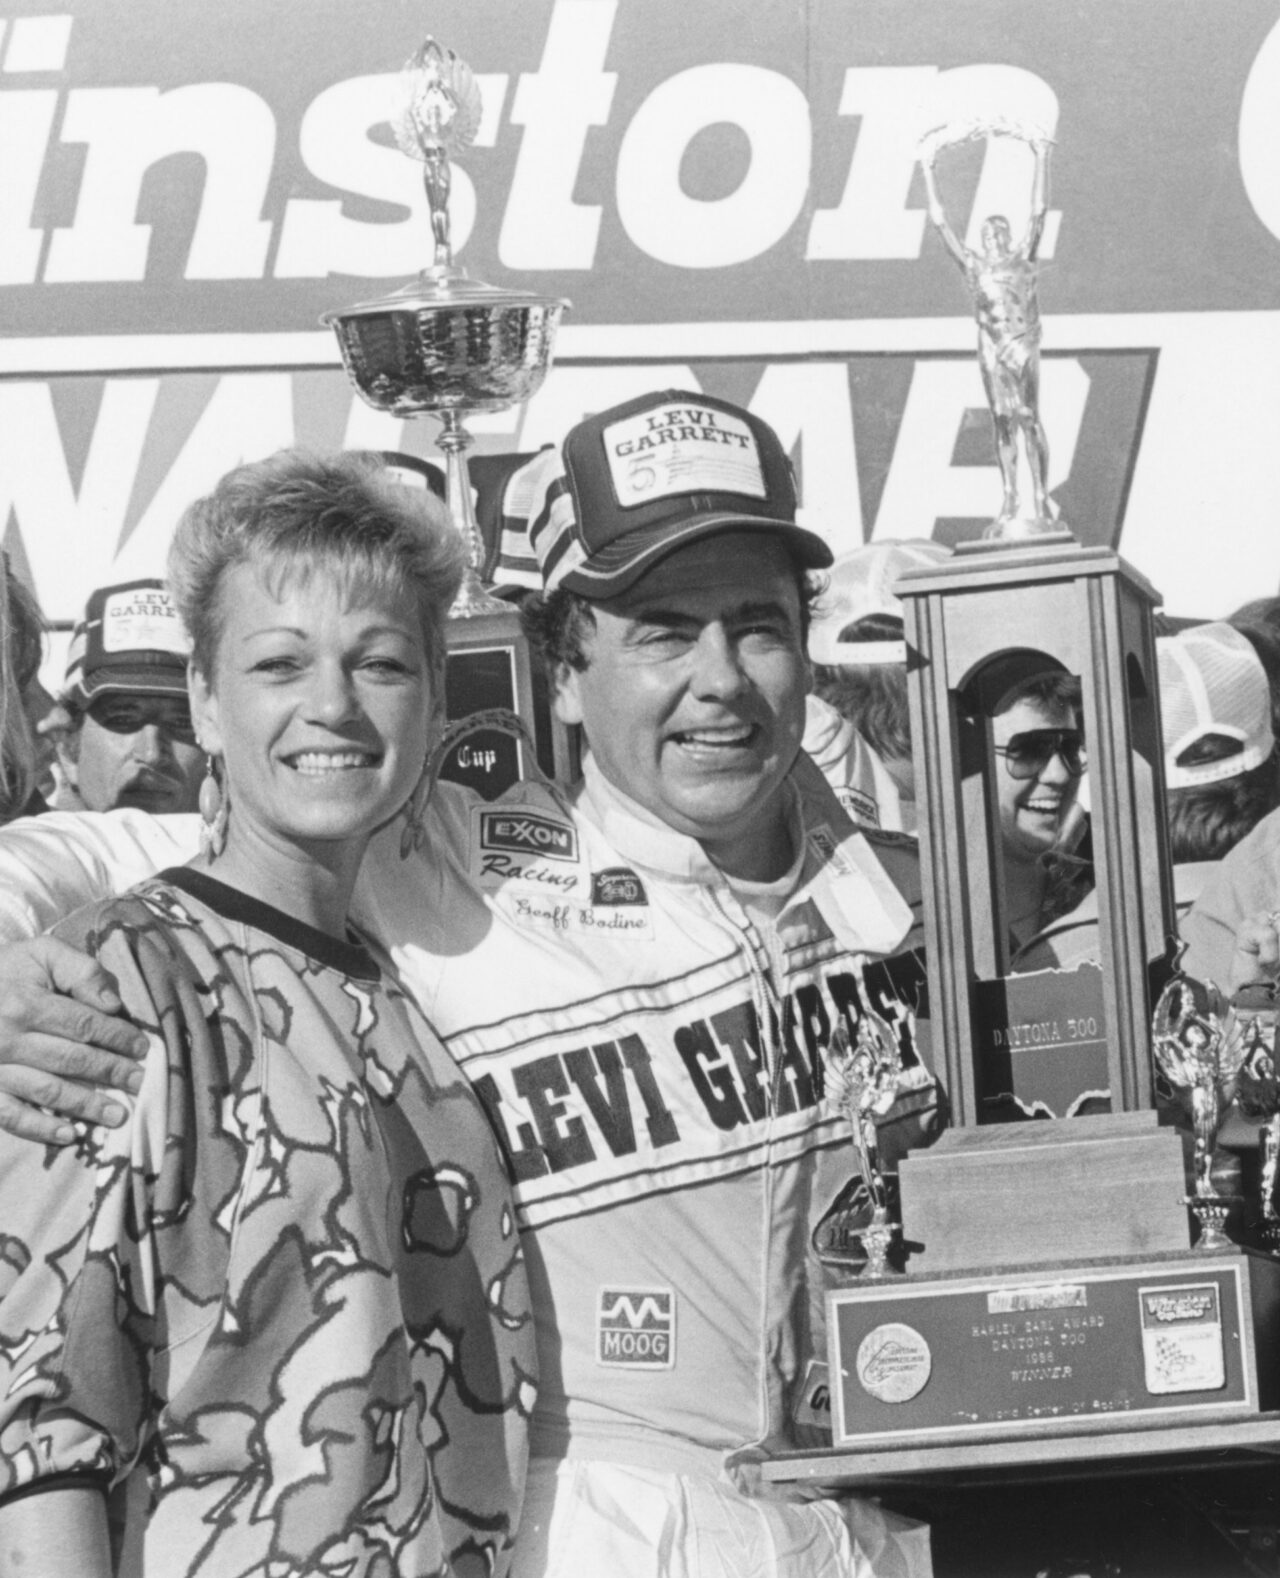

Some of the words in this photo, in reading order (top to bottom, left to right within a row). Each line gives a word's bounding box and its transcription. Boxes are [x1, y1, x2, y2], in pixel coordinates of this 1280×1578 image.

[0, 0, 1061, 285] inston
[646, 409, 718, 432] LEVI
[615, 426, 750, 458] GARRETT
[110, 605, 176, 618] GARRE
[133, 594, 170, 605] LEV
[457, 745, 497, 773] Cup
[495, 820, 569, 848] EXXON
[479, 853, 579, 893] Racing
[578, 907, 647, 930] Bodine
[993, 1023, 1061, 1047] DAYTONA
[1067, 1016, 1097, 1039] 500
[470, 1032, 681, 1186] LEVI
[603, 1332, 666, 1356] MOOG
